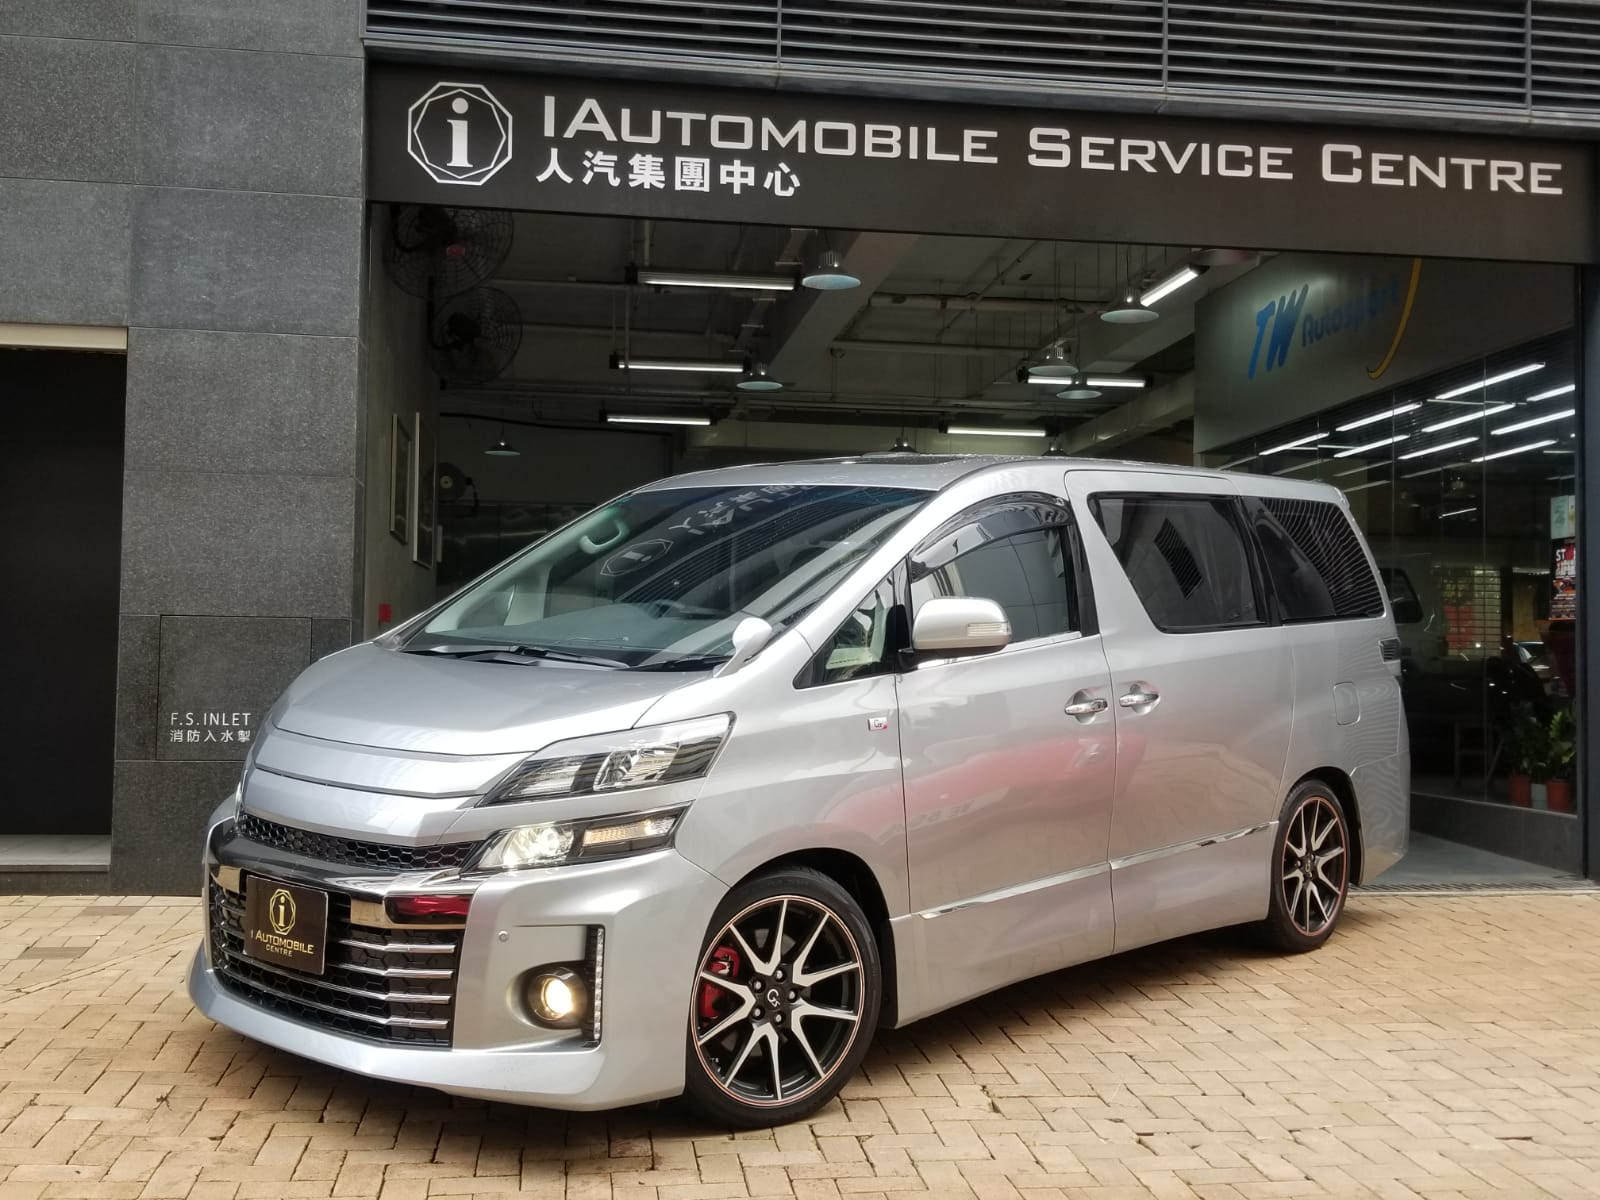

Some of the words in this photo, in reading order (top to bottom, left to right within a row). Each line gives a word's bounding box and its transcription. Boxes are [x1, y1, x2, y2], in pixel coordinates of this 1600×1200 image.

[535, 147, 801, 197] 人汽集團中心
[1027, 127, 1294, 180] SERVICE
[1321, 143, 1563, 196] CENTRE
[1248, 283, 1309, 380] TW
[203, 712, 252, 727] INLET
[255, 929, 315, 955] AUTOMOBILE
[265, 943, 293, 957] CENTRE
